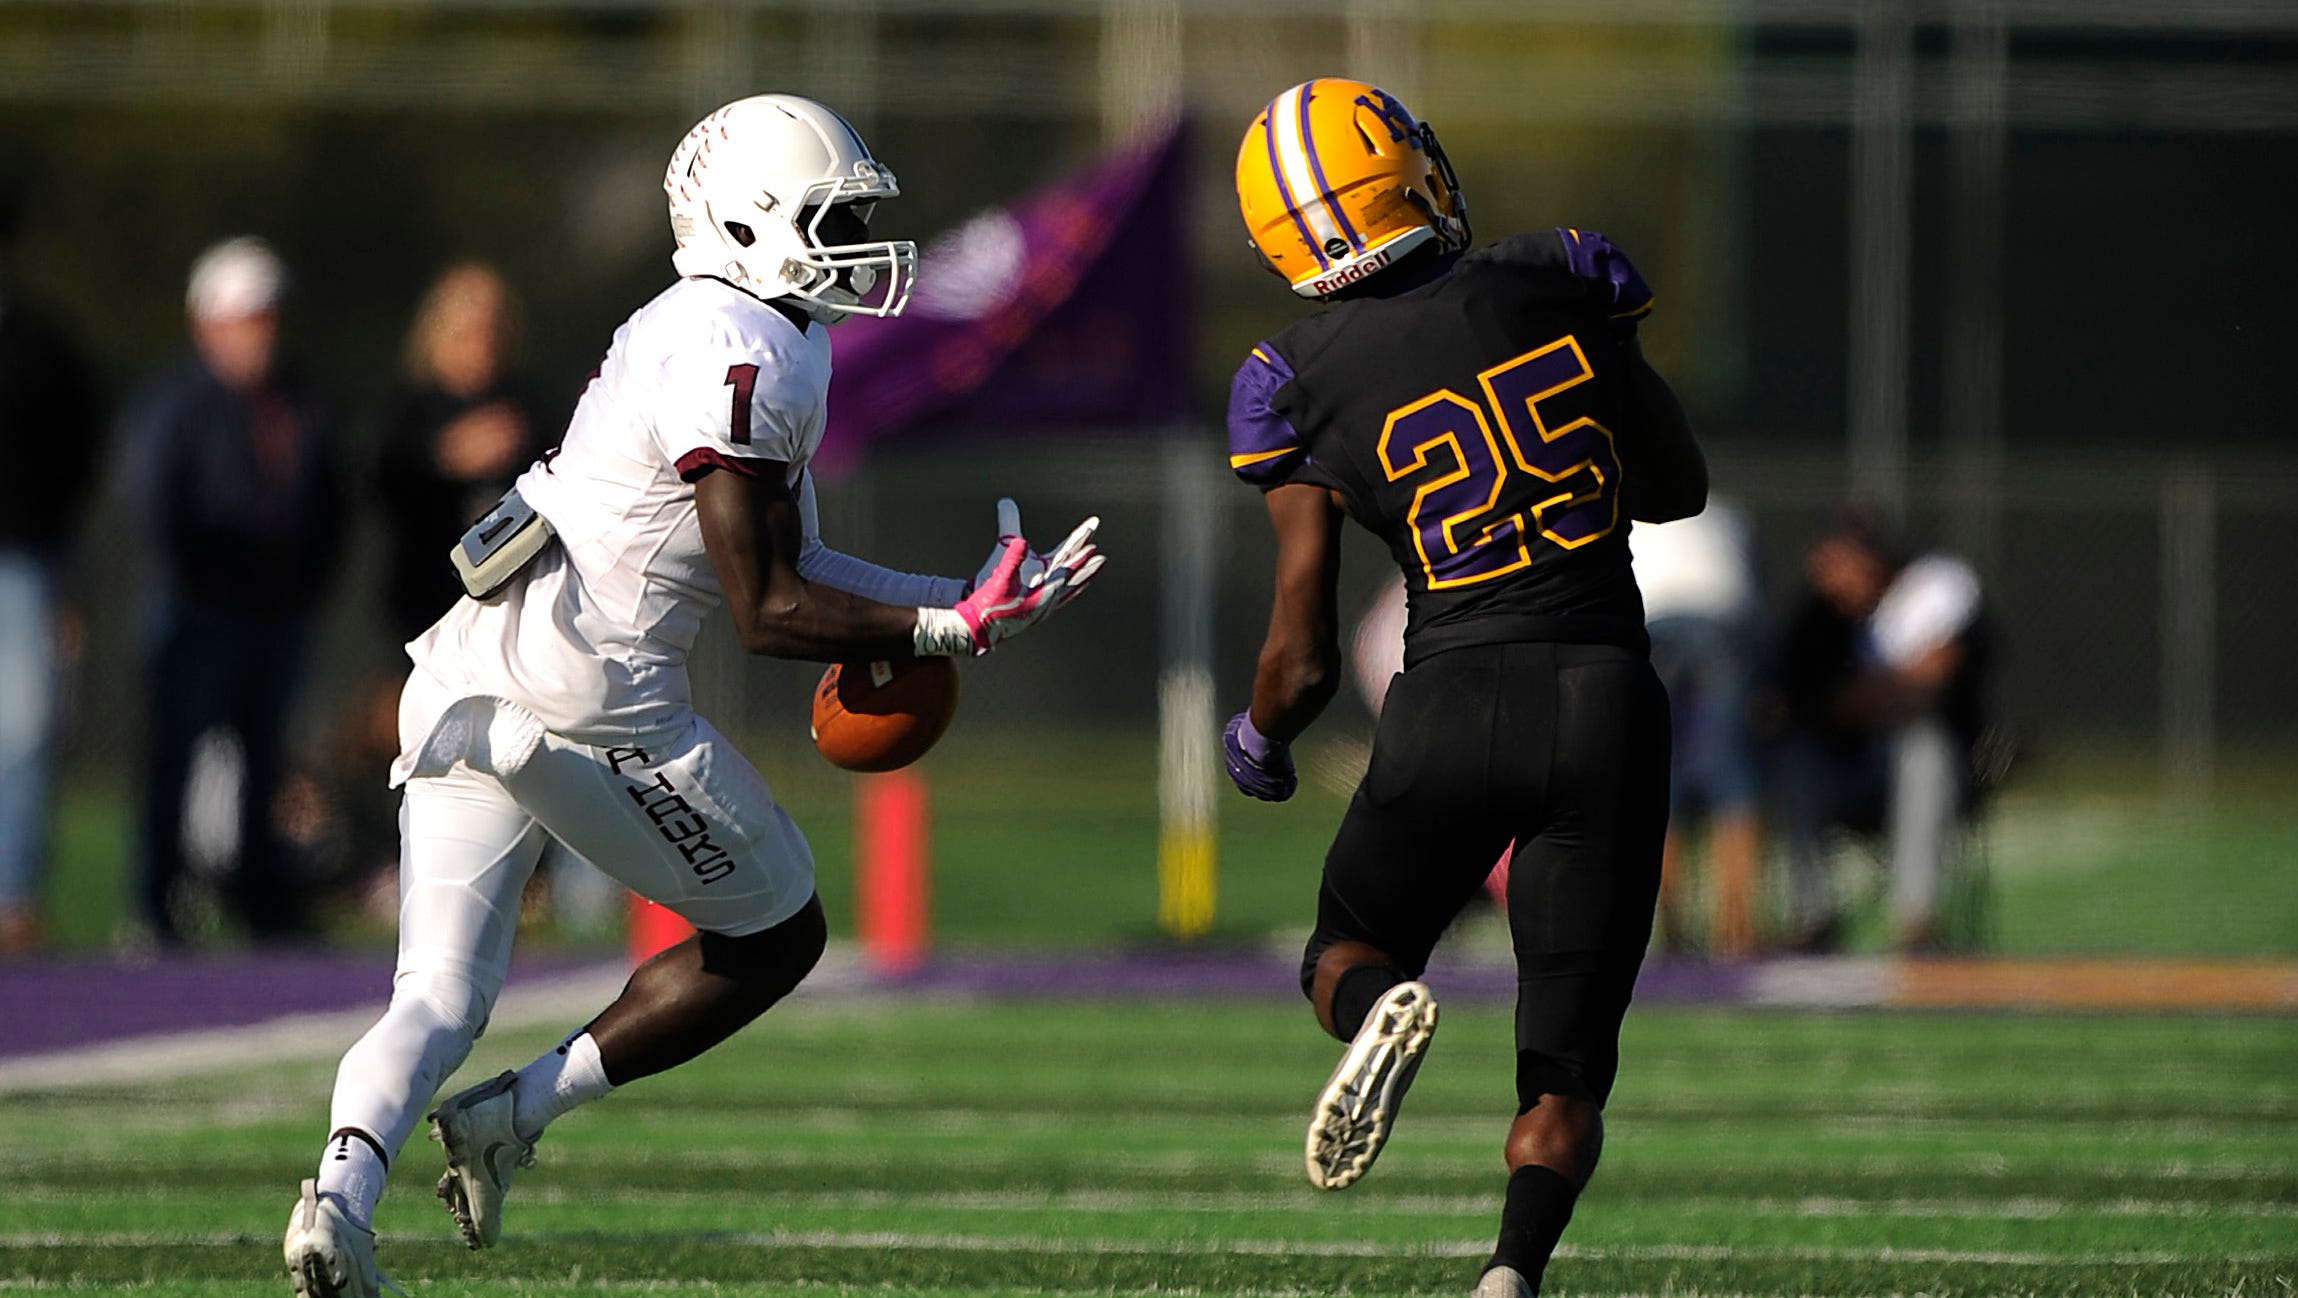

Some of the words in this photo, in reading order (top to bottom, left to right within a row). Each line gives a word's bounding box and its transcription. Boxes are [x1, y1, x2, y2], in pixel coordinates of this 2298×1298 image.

[1312, 250, 1391, 296] Riddell
[724, 363, 760, 445] 1
[1376, 334, 1622, 590] 25
